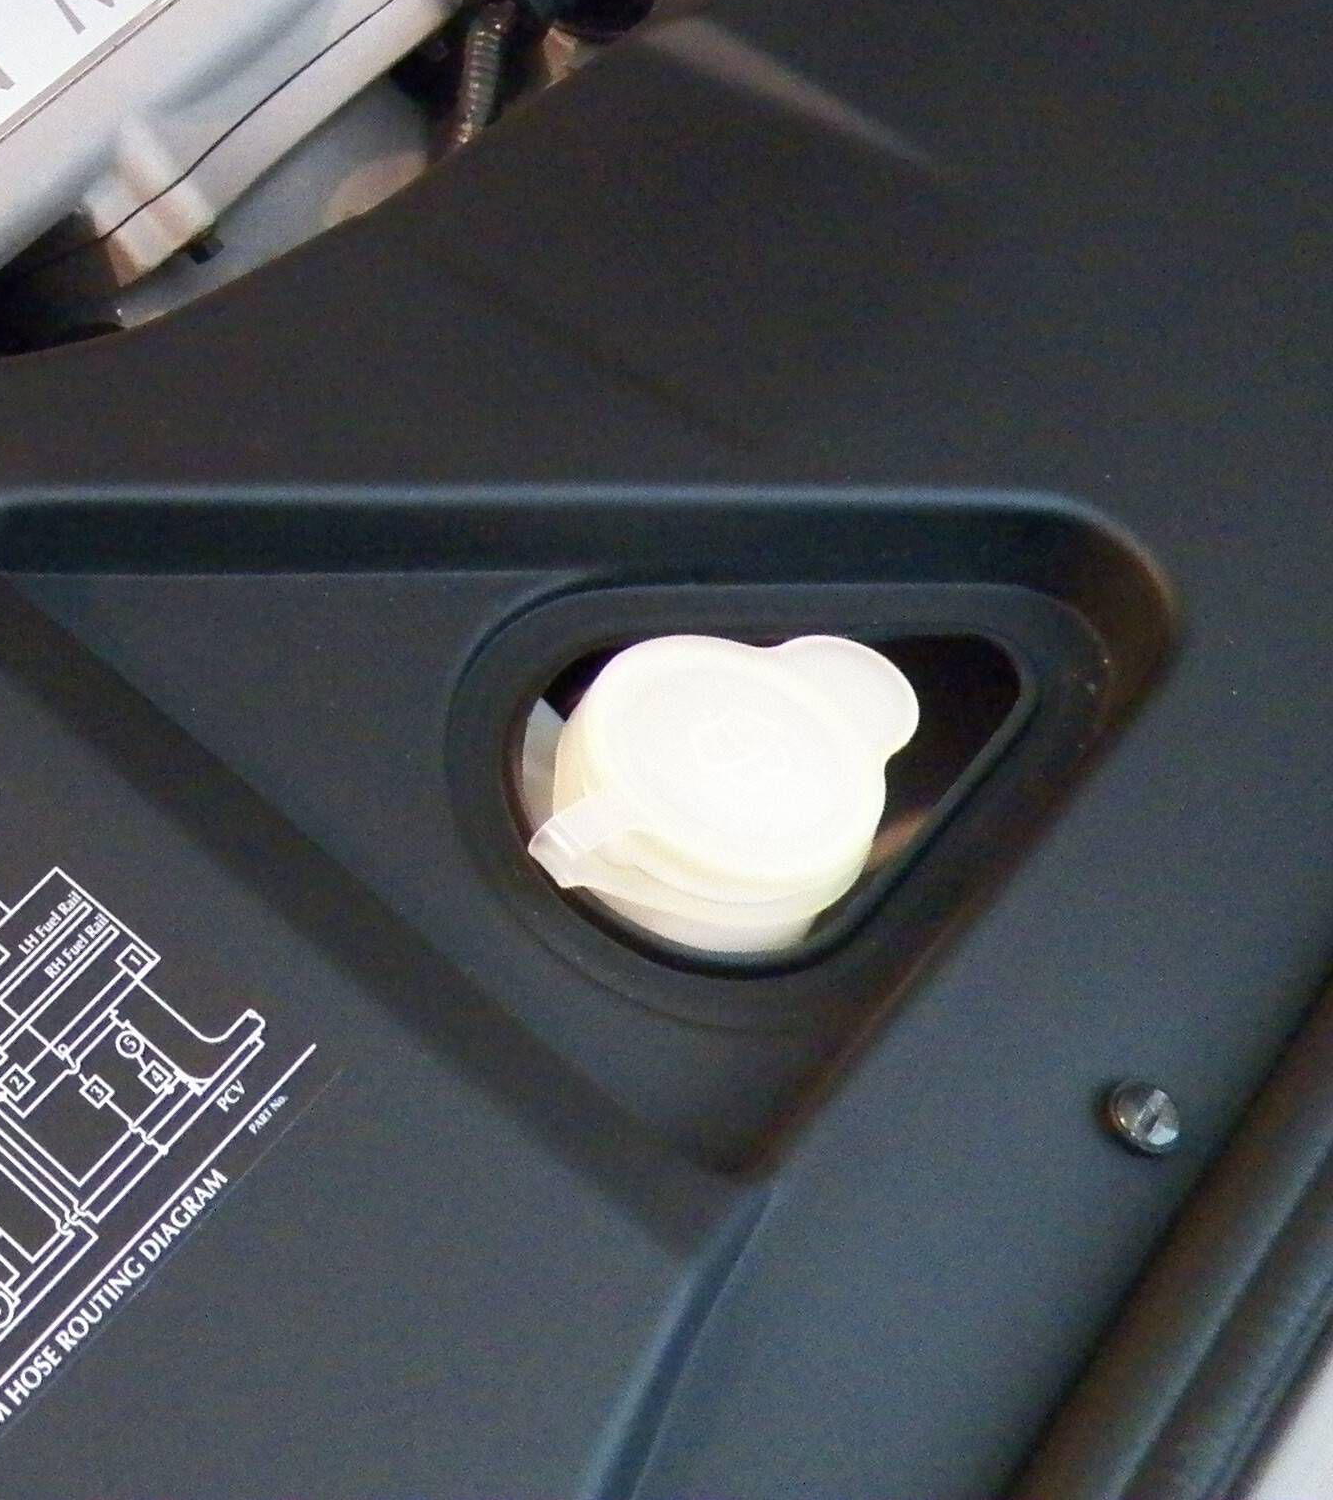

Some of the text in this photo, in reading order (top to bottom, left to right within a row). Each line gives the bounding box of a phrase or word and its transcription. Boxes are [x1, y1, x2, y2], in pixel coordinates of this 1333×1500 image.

[18, 890, 81, 954] LH Fuel Rail
[43, 912, 109, 978] RH Fuel Rail
[129, 954, 141, 965] 1
[122, 1036, 136, 1051] 5
[9, 1075, 24, 1090] 2
[151, 1069, 163, 1082] 4
[89, 1084, 104, 1098] 3
[216, 1079, 244, 1112] PCV
[248, 1095, 287, 1133] PART No.
[4, 1344, 61, 1405] HOSE
[54, 1256, 145, 1352] ROUTING
[138, 1168, 227, 1261] DIAGRAM
